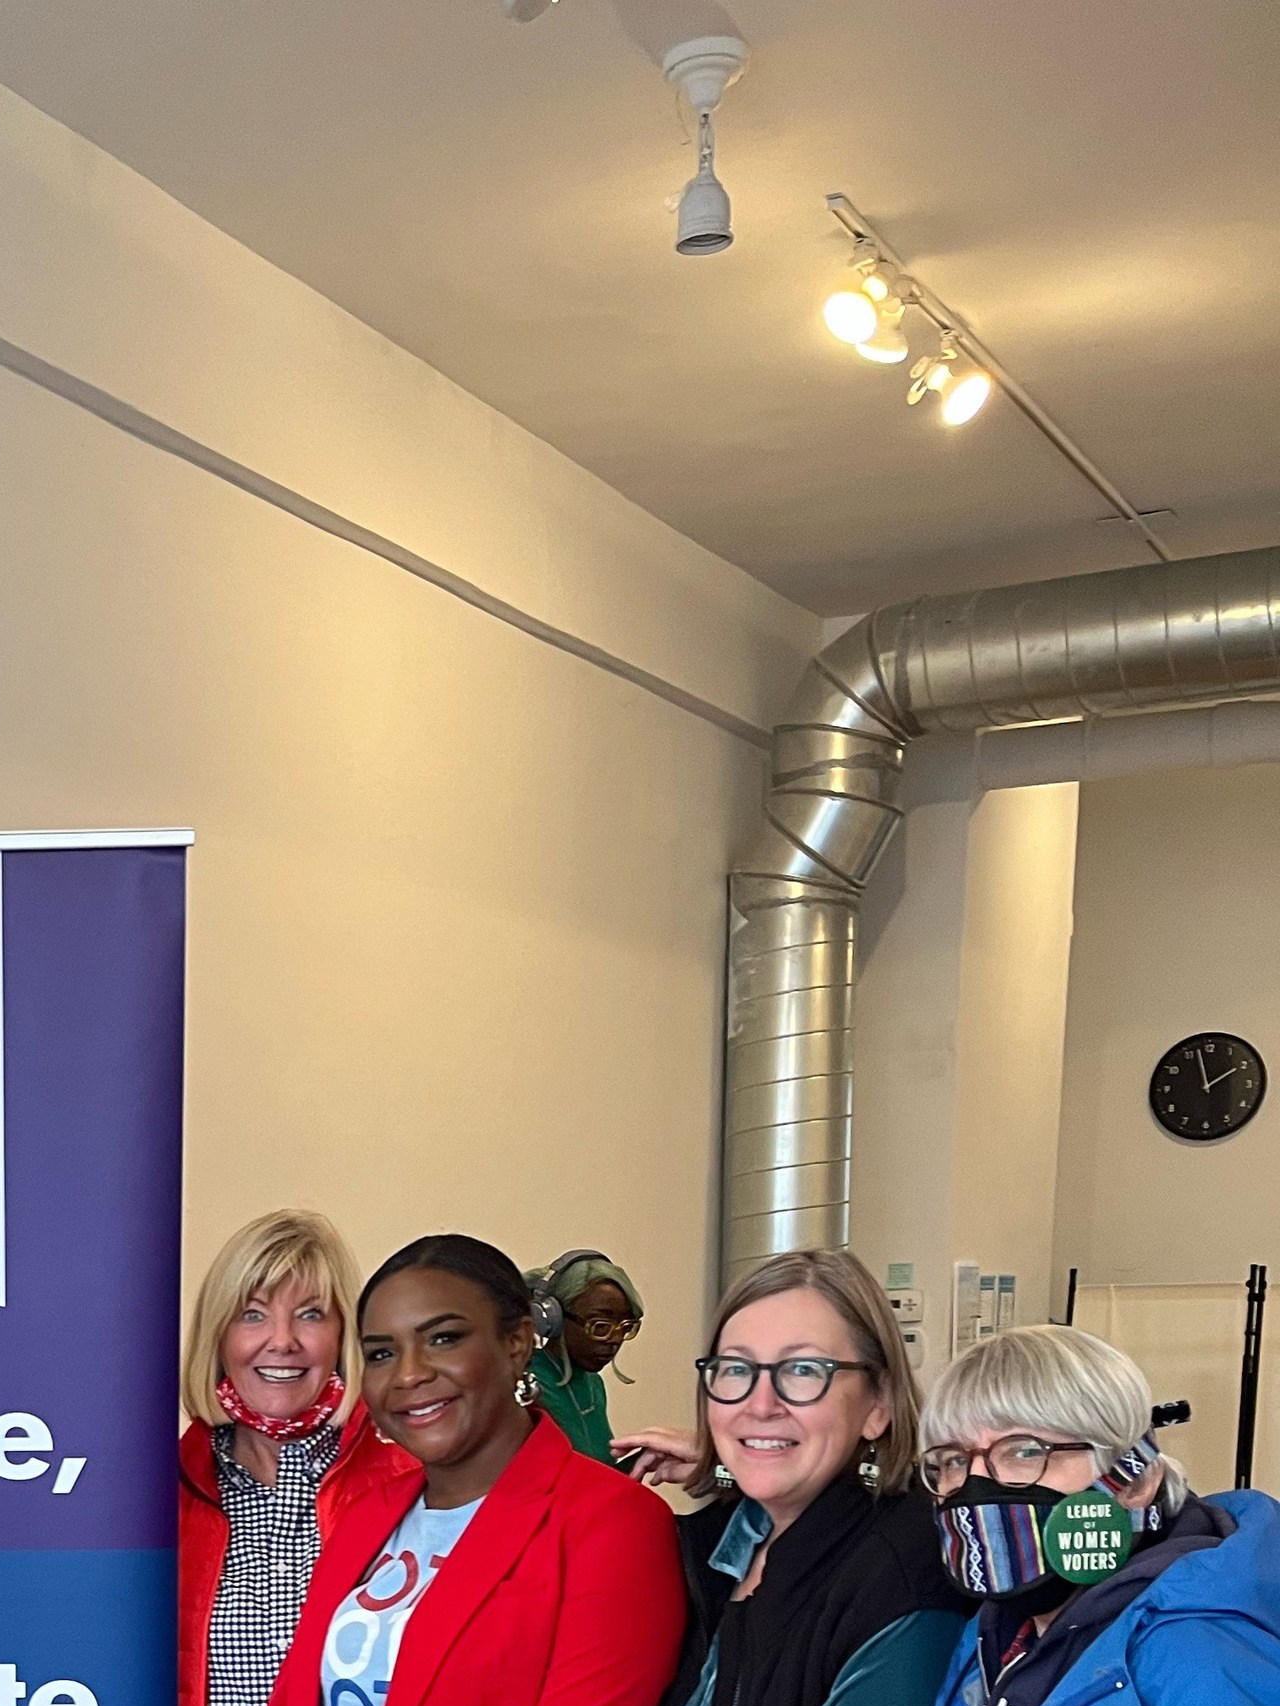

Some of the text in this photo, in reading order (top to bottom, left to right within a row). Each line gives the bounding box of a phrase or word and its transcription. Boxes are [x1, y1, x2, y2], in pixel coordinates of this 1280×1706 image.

[1066, 1504, 1112, 1519] LEAGUE
[1058, 1530, 1121, 1550] WOMEN
[1062, 1552, 1117, 1571] VOTERS
